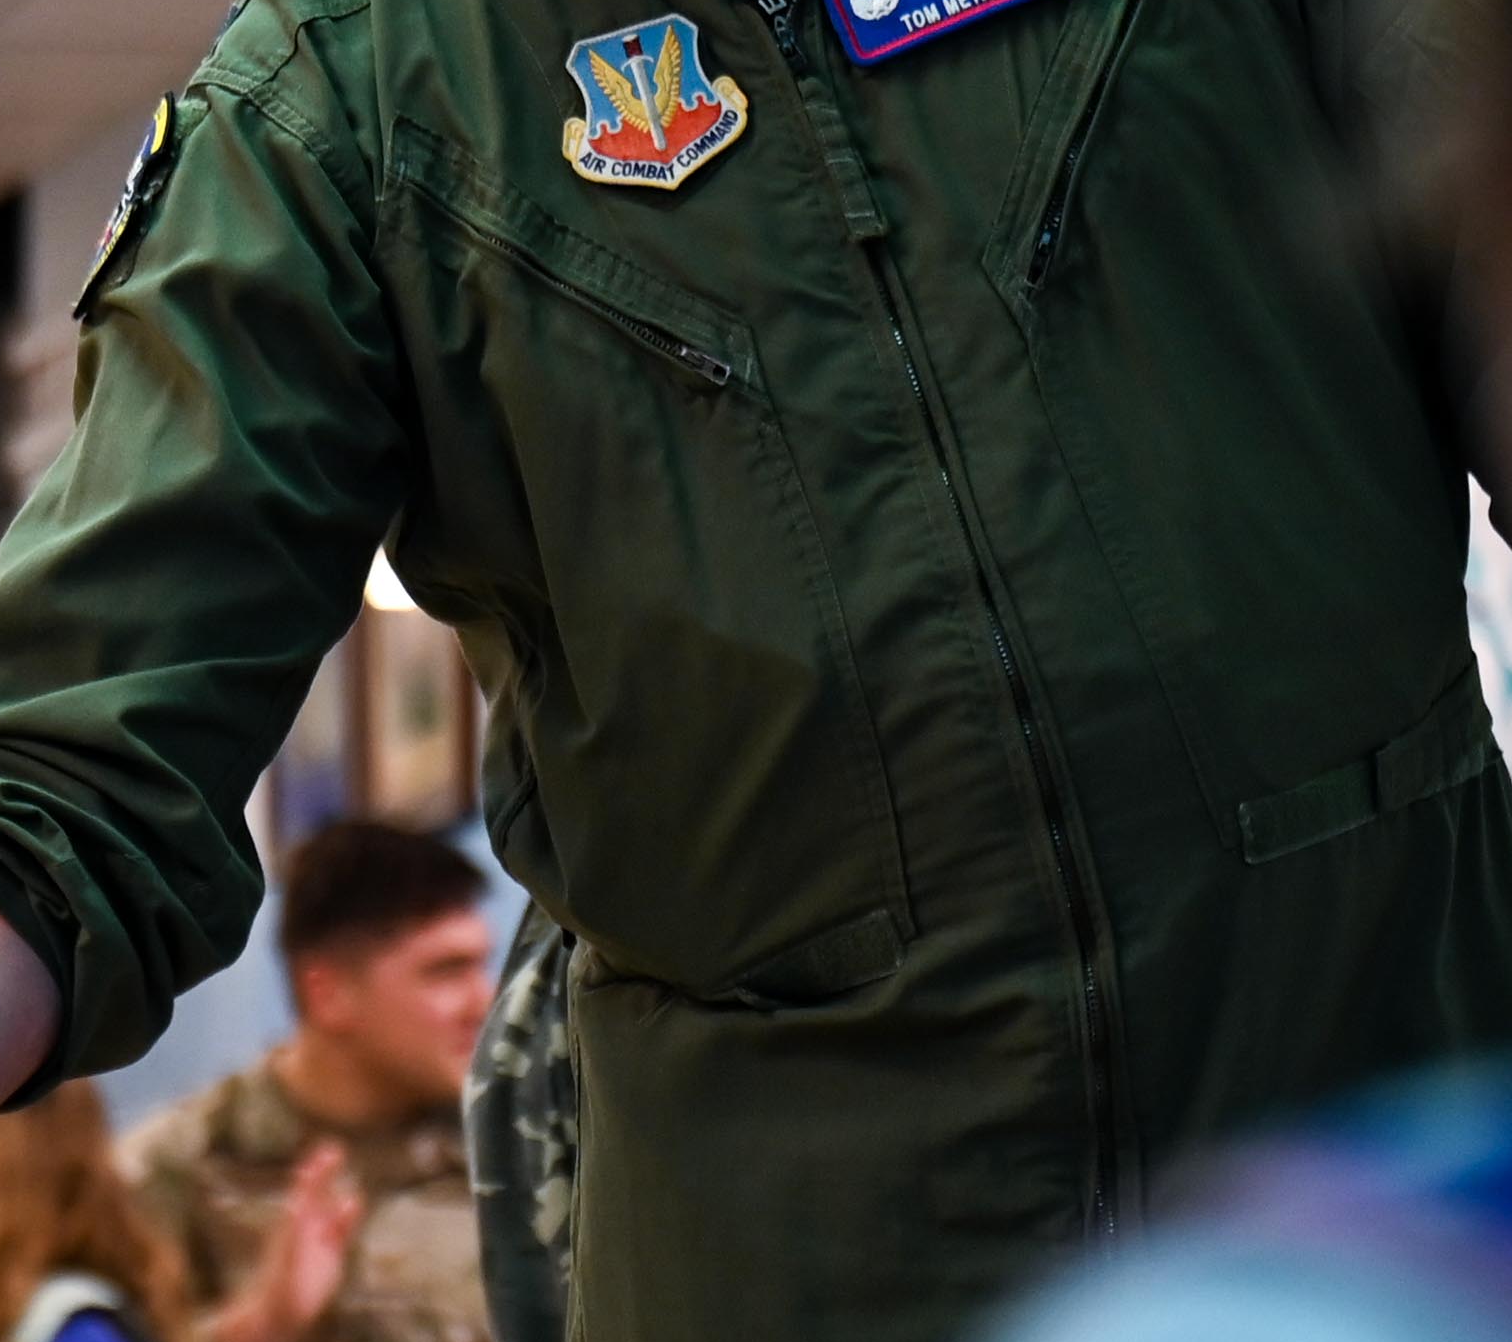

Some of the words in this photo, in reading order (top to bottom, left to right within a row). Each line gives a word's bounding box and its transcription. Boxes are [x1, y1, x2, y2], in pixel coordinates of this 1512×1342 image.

[900, 2, 941, 33] TOM
[580, 152, 607, 174] AIR
[611, 162, 676, 181] COMBAT
[676, 109, 739, 168] COMMAND
